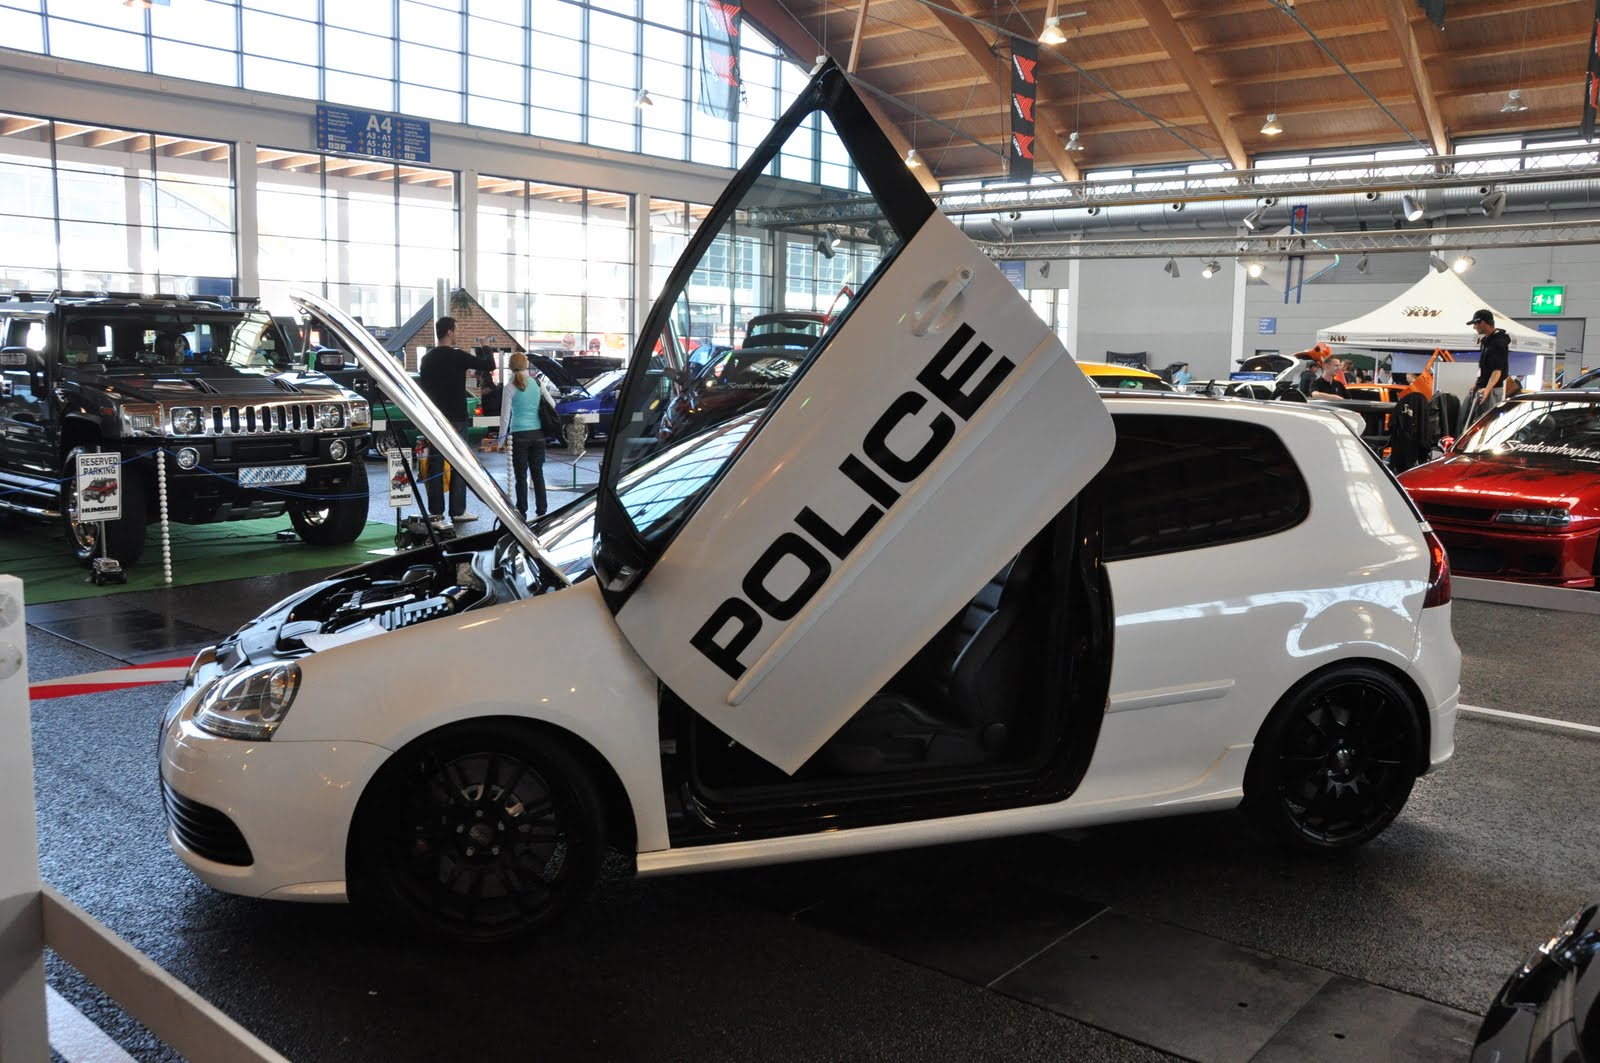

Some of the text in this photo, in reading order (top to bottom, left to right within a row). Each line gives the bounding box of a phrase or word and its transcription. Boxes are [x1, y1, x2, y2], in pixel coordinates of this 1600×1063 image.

[366, 114, 393, 134] A4
[366, 132, 376, 140] A3
[382, 134, 391, 142] A1
[367, 147, 376, 155] B1
[1406, 308, 1443, 318] KW
[1329, 334, 1348, 343] KW
[1505, 440, 1600, 459] Speedcowboys.a
[80, 457, 118, 467] RESERVED
[83, 466, 116, 475] PARKING
[689, 322, 1017, 681] POLICE
[81, 505, 118, 513] HUMMER
